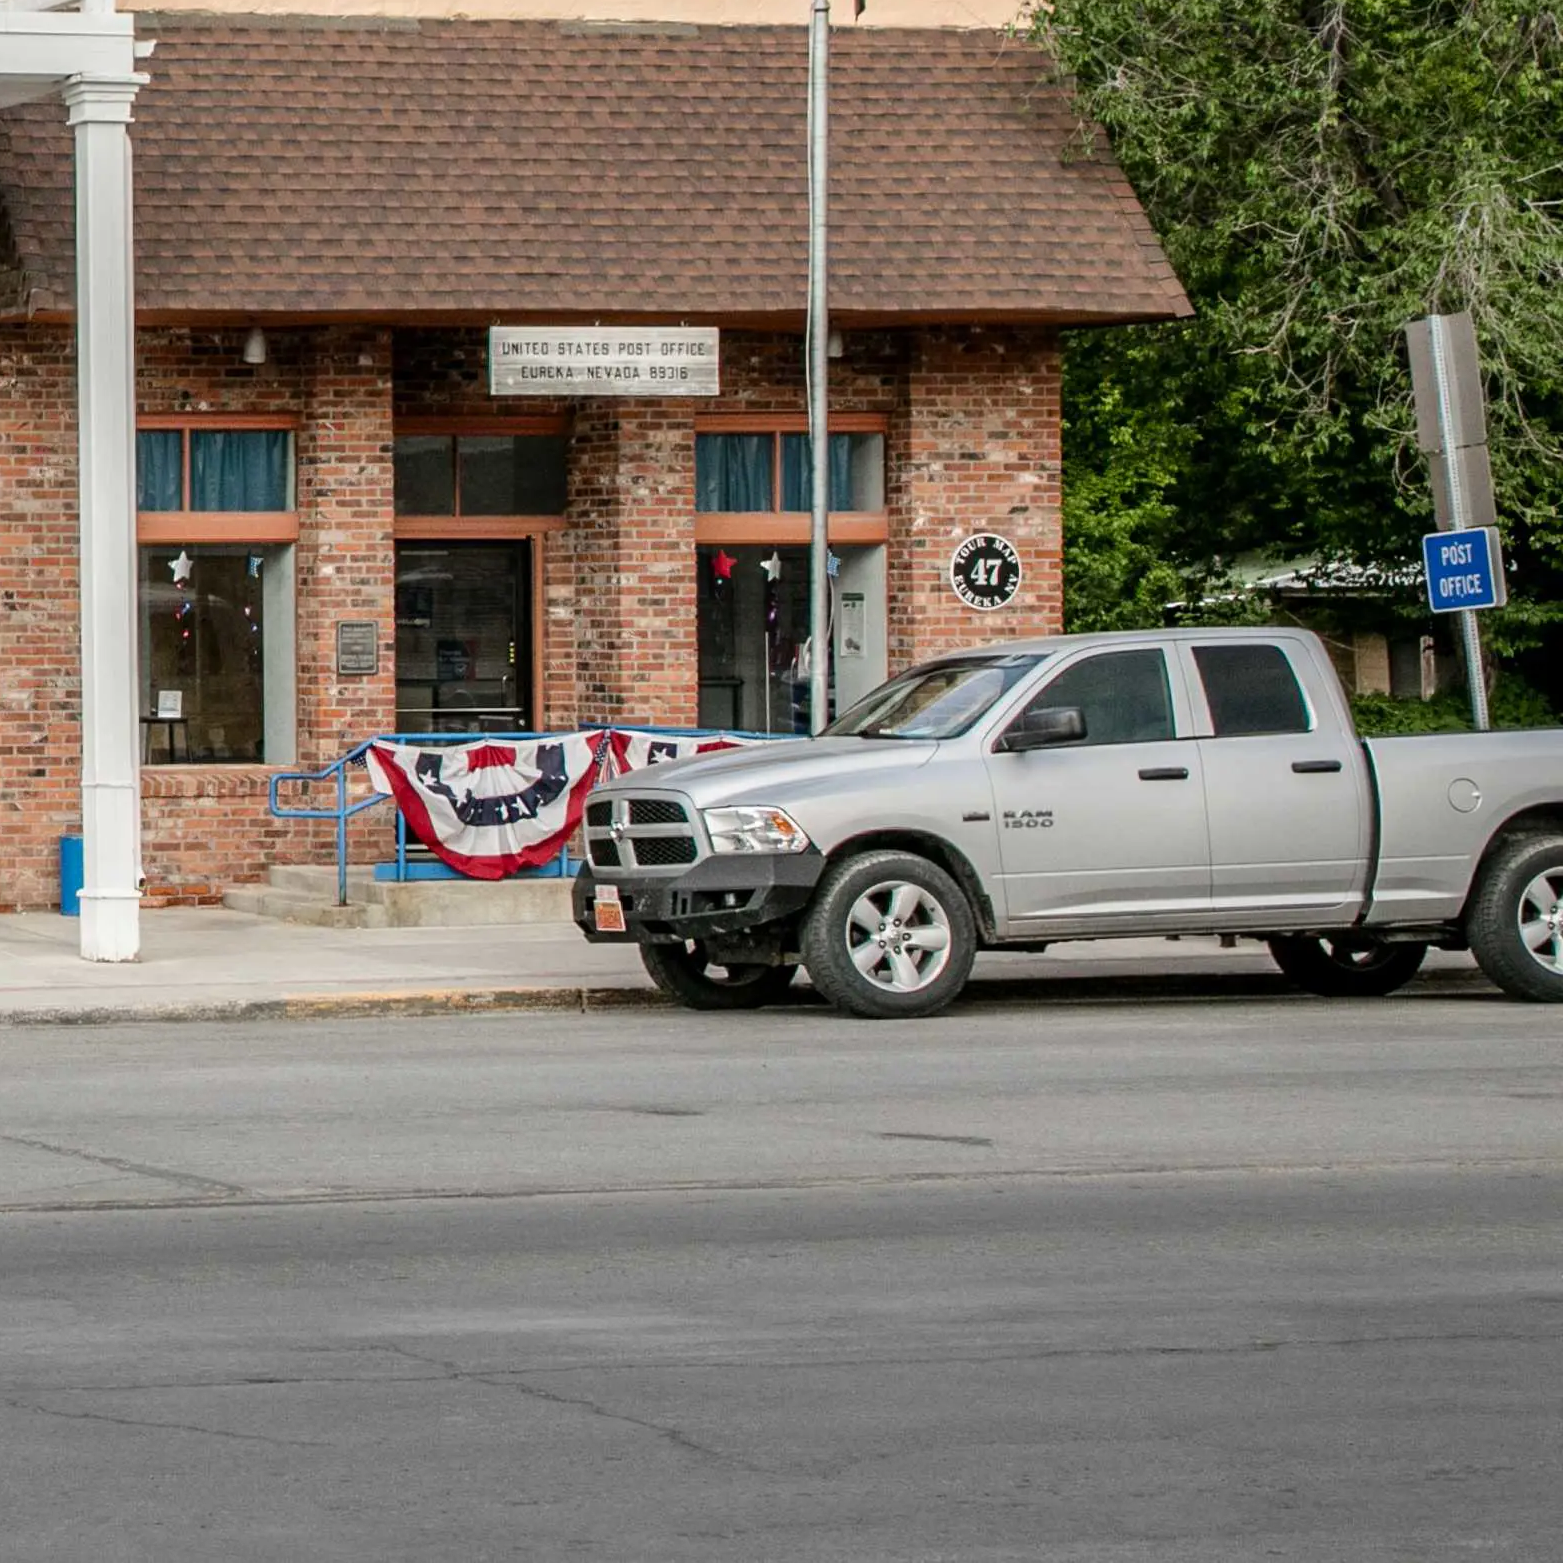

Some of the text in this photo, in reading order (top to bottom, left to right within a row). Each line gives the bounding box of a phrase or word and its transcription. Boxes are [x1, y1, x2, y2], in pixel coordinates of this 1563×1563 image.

[502, 342, 705, 356] UNITED STATES POST OFFICE
[587, 366, 640, 379] NEVADA
[649, 366, 688, 379] 89316
[955, 537, 1017, 564] TOUR MAP
[1440, 543, 1472, 566] POST
[970, 558, 1003, 586] 47
[955, 573, 1018, 607] EUREKA NV
[1439, 573, 1483, 598] OFFICE
[1003, 810, 1053, 818] RAM
[1004, 818, 1053, 829] 1500
